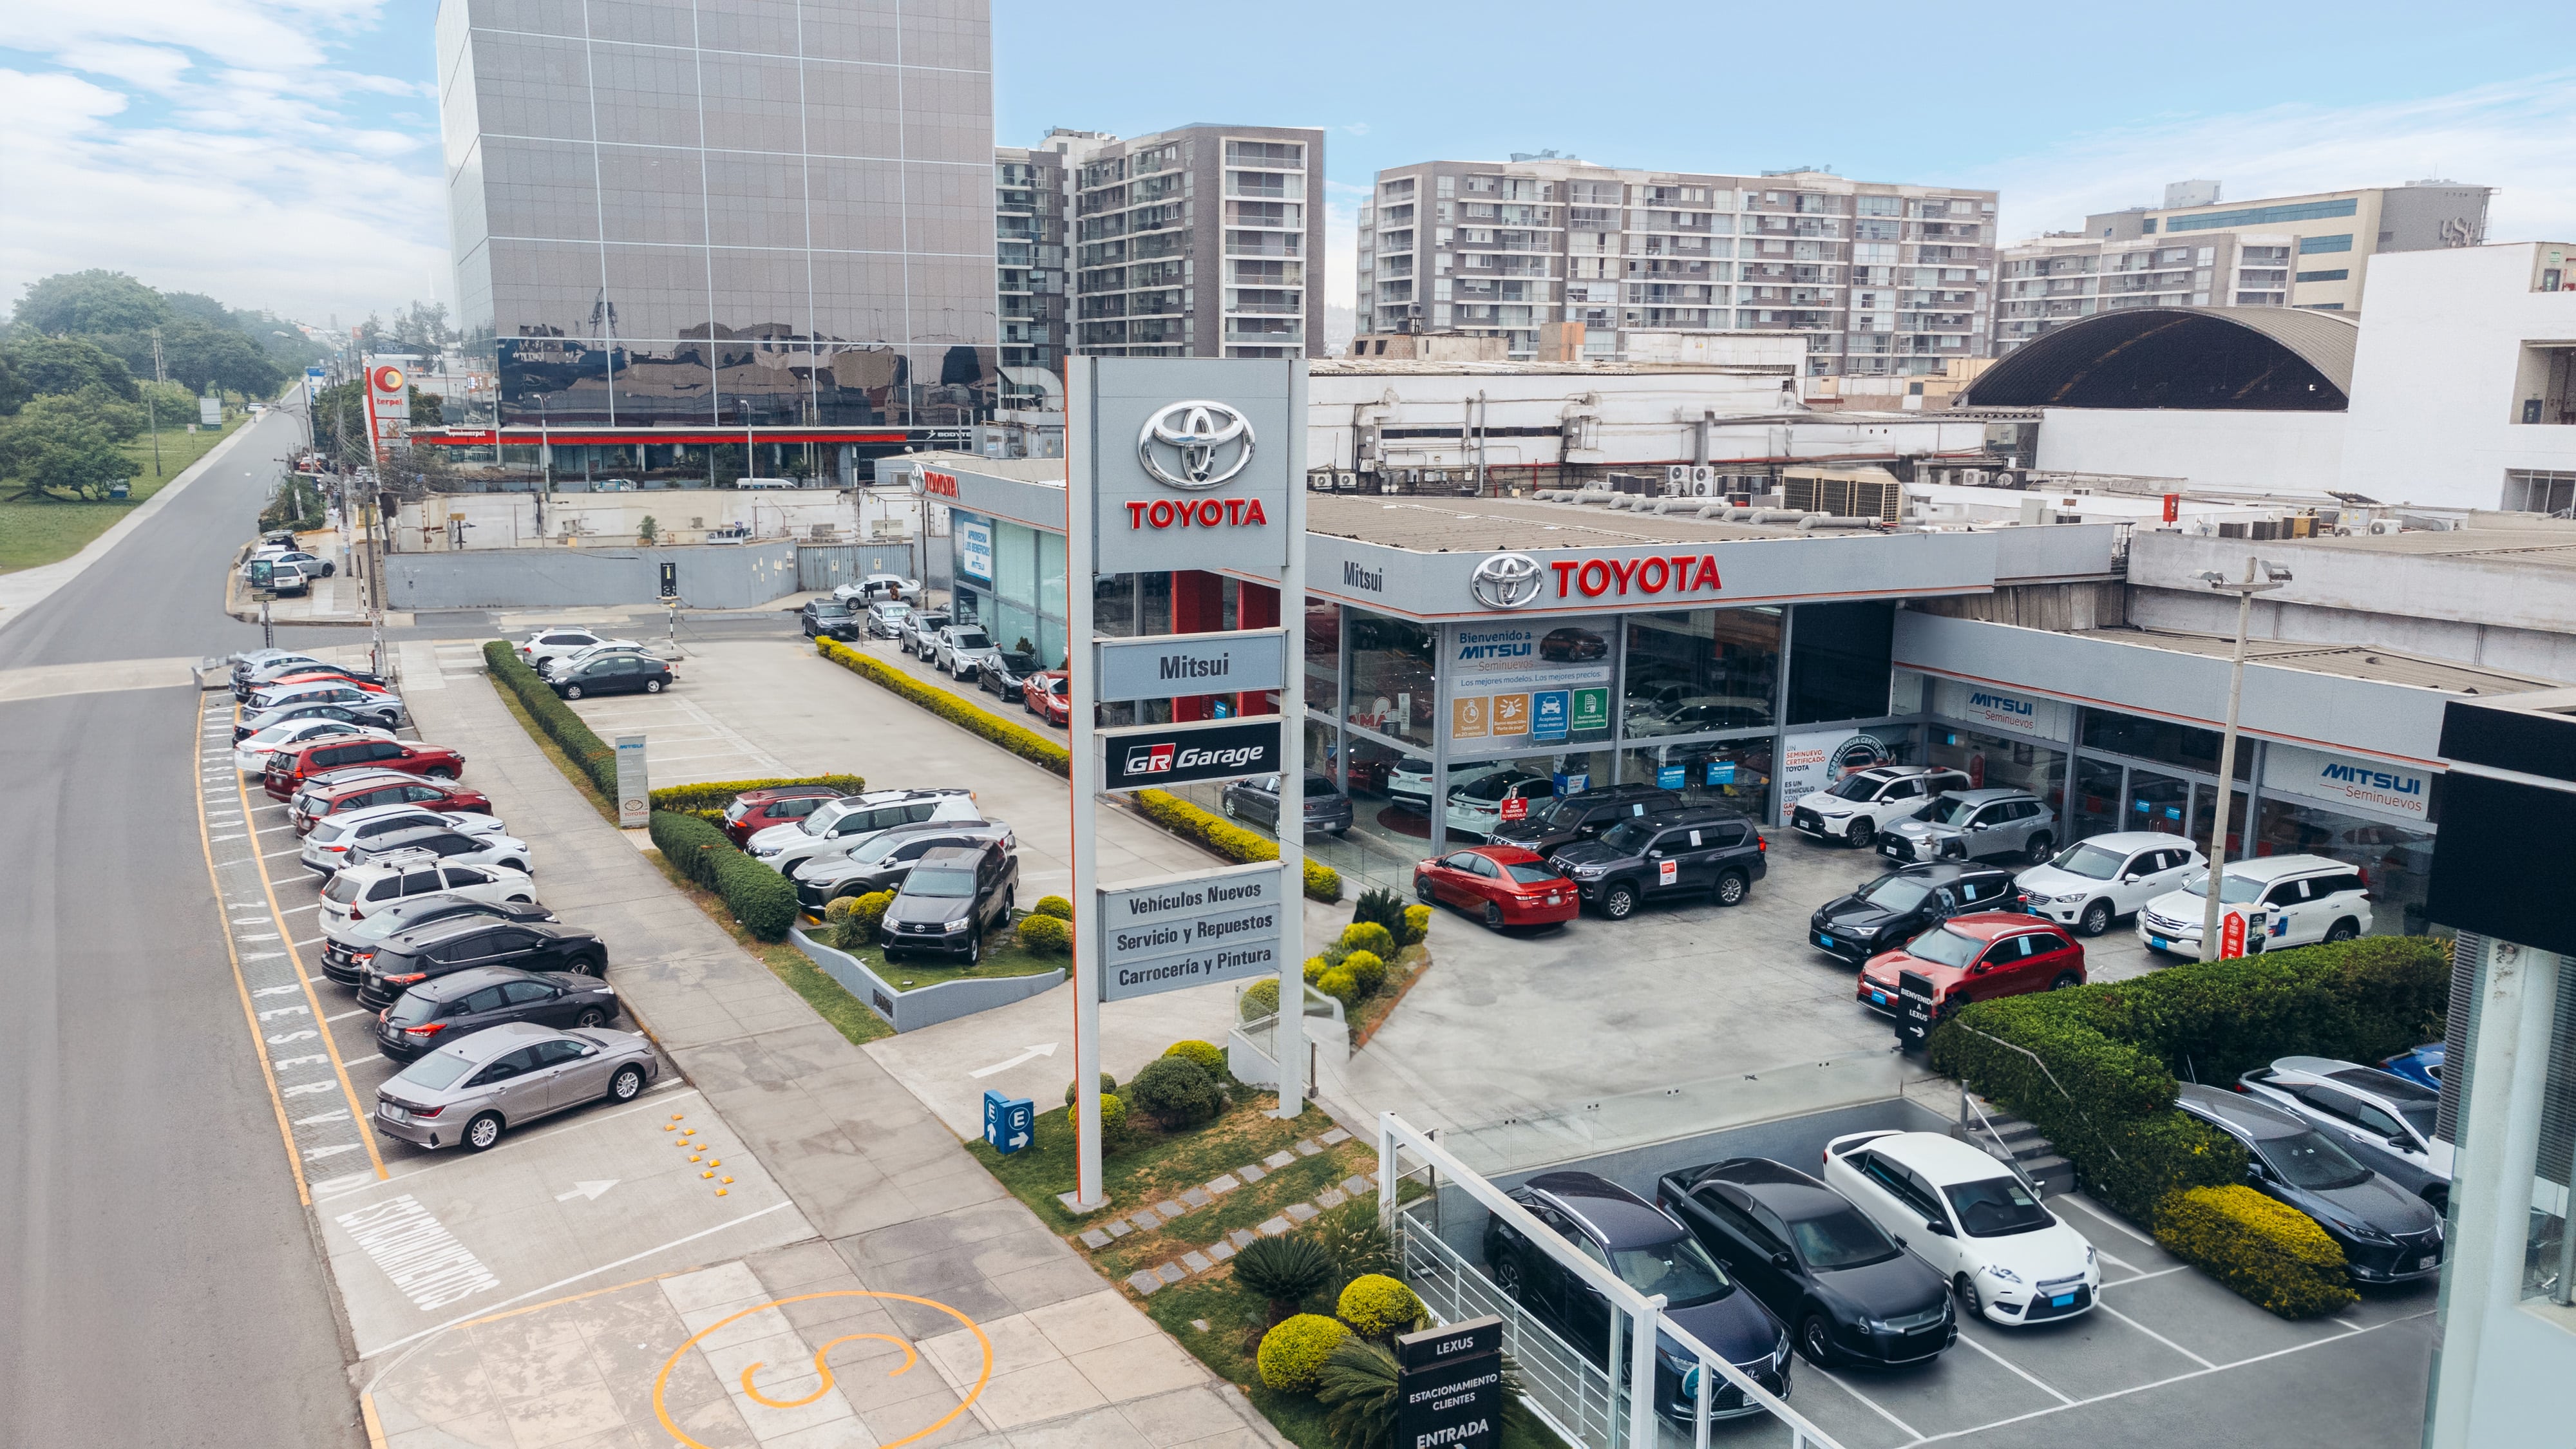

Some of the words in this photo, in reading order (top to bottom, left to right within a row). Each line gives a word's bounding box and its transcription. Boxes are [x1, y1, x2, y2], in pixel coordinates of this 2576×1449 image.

[376, 397, 404, 407] terpel
[924, 471, 960, 499] TOYOTA
[1125, 498, 1267, 530] TOYOTA
[1343, 560, 1383, 592] Mitsui
[1549, 554, 1723, 598] TOYOTA
[1459, 629, 1522, 644] Bienvenido
[1524, 630, 1531, 639] a
[1458, 643, 1531, 659] MITSUI
[1160, 652, 1229, 679] Mitsui
[1479, 659, 1534, 671] Seminuevos
[1475, 677, 1502, 687] mejores
[1503, 675, 1533, 684] modelos.
[1535, 674, 1548, 682] Los
[1548, 672, 1575, 681] mejores
[1576, 670, 1603, 680] precios.
[1969, 692, 2032, 716] MITSUI
[1985, 710, 2034, 729] Seminuevos
[1128, 753, 1172, 773] GR
[1177, 746, 1264, 768] Garage
[1786, 750, 1823, 758] SEMINUEVO
[1786, 756, 1826, 766] CERTIFICADO
[1786, 764, 1810, 773] TOYOTA
[2320, 763, 2421, 795] MITSUI
[1783, 794, 1798, 802] CON
[1785, 786, 1815, 795] VEHÍCULO
[2345, 784, 2423, 812] Seminuevos
[1130, 891, 1202, 915] Vehículos
[1208, 884, 1262, 903] Nuevos
[1117, 927, 1178, 951] Servicio
[1183, 928, 1192, 944] y
[1197, 914, 1273, 939] Repuestos
[1119, 958, 1198, 986] Carrocería
[1203, 959, 1213, 975] y
[1217, 949, 1271, 969] Pintura
[1909, 1009, 1928, 1021] LEXUS
[1916, 1003, 1922, 1011] A
[988, 1103, 996, 1120] E
[1014, 1110, 1025, 1127] E
[1437, 1337, 1473, 1355] LEXUS
[1410, 1373, 1498, 1404] ESTACIONAMIENTO
[1432, 1392, 1476, 1410] CLIENTES
[1417, 1418, 1490, 1449] ENTRADA
